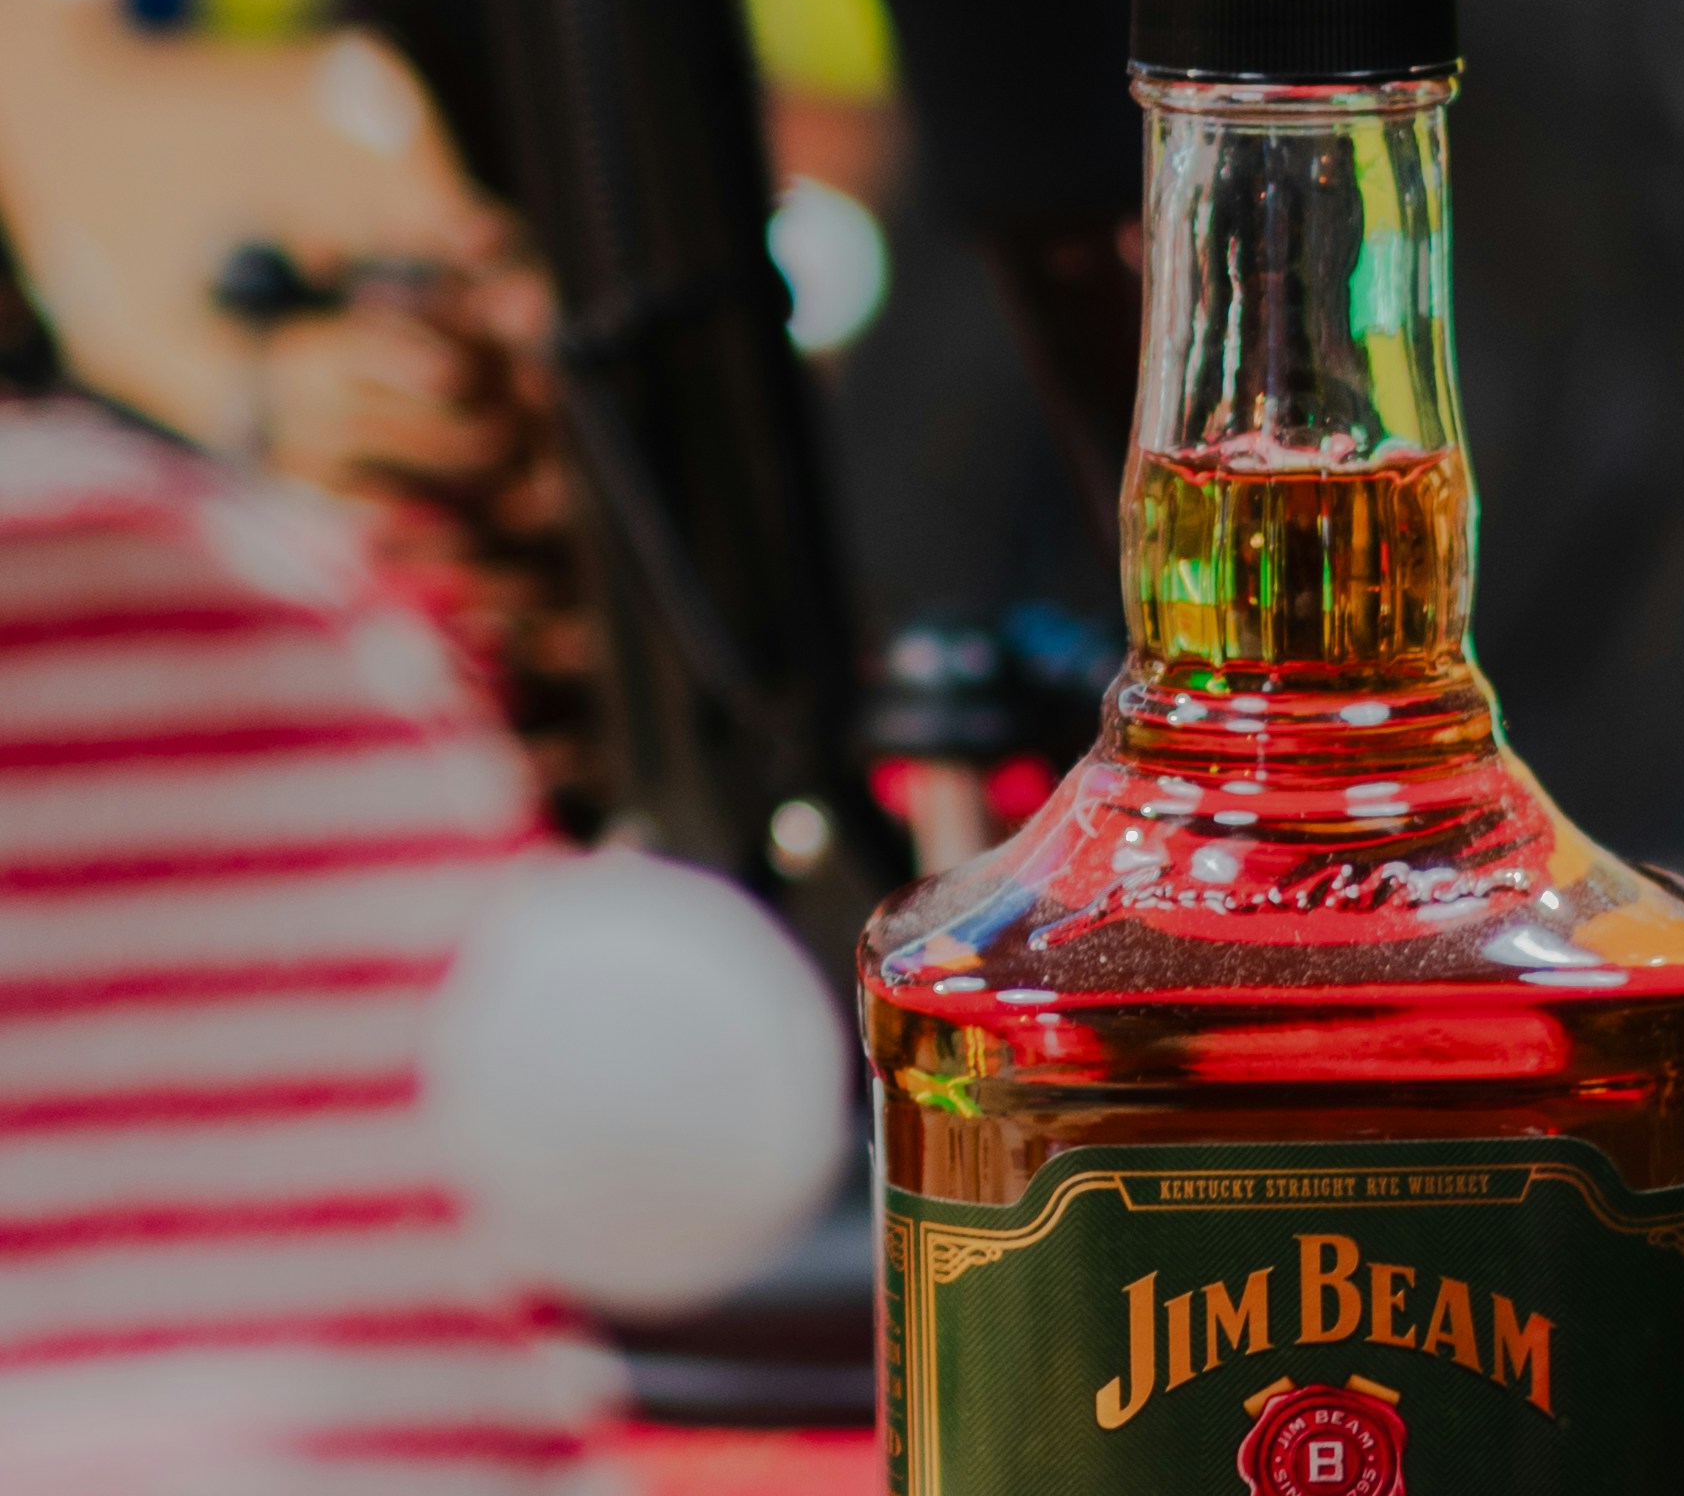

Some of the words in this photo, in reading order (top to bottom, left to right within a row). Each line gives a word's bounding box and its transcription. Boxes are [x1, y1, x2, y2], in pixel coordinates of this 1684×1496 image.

[1159, 1179, 1255, 1201] KENTUCKY
[1265, 1177, 1355, 1199] STRAIGHT
[1366, 1176, 1400, 1197] RYE
[1408, 1174, 1491, 1195] WHISKEY
[1095, 1266, 1275, 1430] JIM
[1293, 1233, 1557, 1420] BEAM
[1278, 1417, 1306, 1449] JIM
[1315, 1409, 1375, 1449] BEAM
[1309, 1440, 1344, 1482] B
